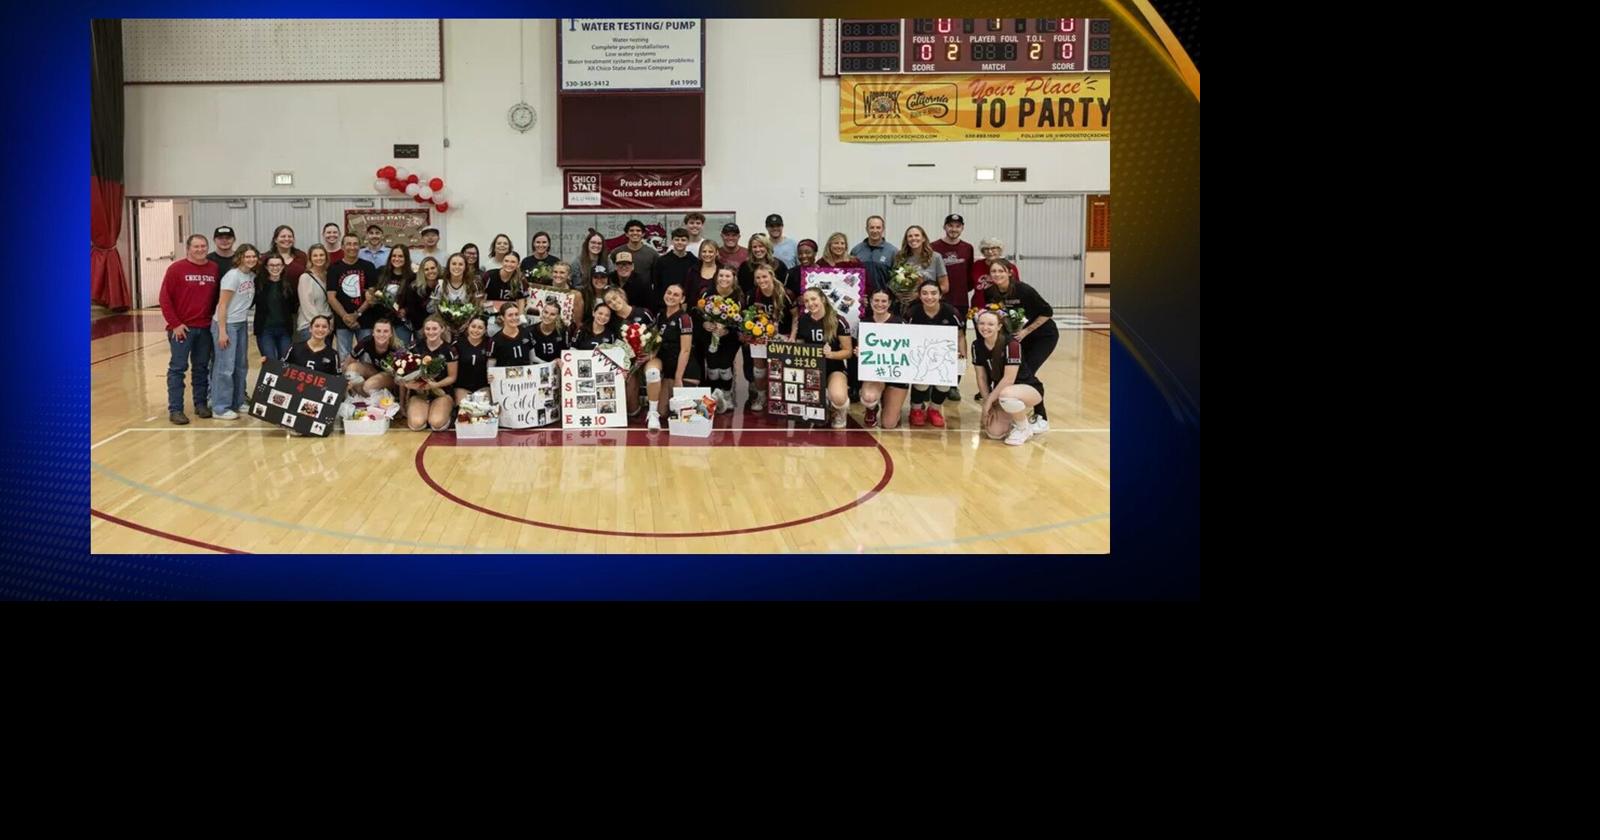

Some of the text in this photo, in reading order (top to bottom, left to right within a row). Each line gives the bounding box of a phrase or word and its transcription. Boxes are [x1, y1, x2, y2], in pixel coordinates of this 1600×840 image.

[582, 21, 696, 31] WATER TESTING/ PUMP
[970, 35, 996, 43] PLAYER
[922, 44, 932, 60] 0
[947, 44, 958, 60] 2
[1030, 43, 1041, 60] 2
[1062, 43, 1073, 59] 0
[969, 76, 1080, 100] Your Place
[972, 97, 1110, 128] TO PARTY
[573, 183, 596, 191] STATE
[644, 179, 673, 188] Sponsor
[612, 188, 690, 197] Chico State Athletics!
[500, 289, 510, 299] 12
[812, 329, 823, 341] 16
[865, 333, 910, 351] GWYN
[512, 346, 523, 358] 11
[542, 343, 554, 354] 13
[768, 343, 824, 358] GWYNNIE
[472, 354, 476, 366] 1
[794, 358, 817, 368] #16
[860, 351, 910, 366] ZILLA
[306, 360, 315, 370] 5
[875, 365, 902, 378] #16
[283, 368, 326, 388] JESSIE
[580, 416, 606, 426] #10
